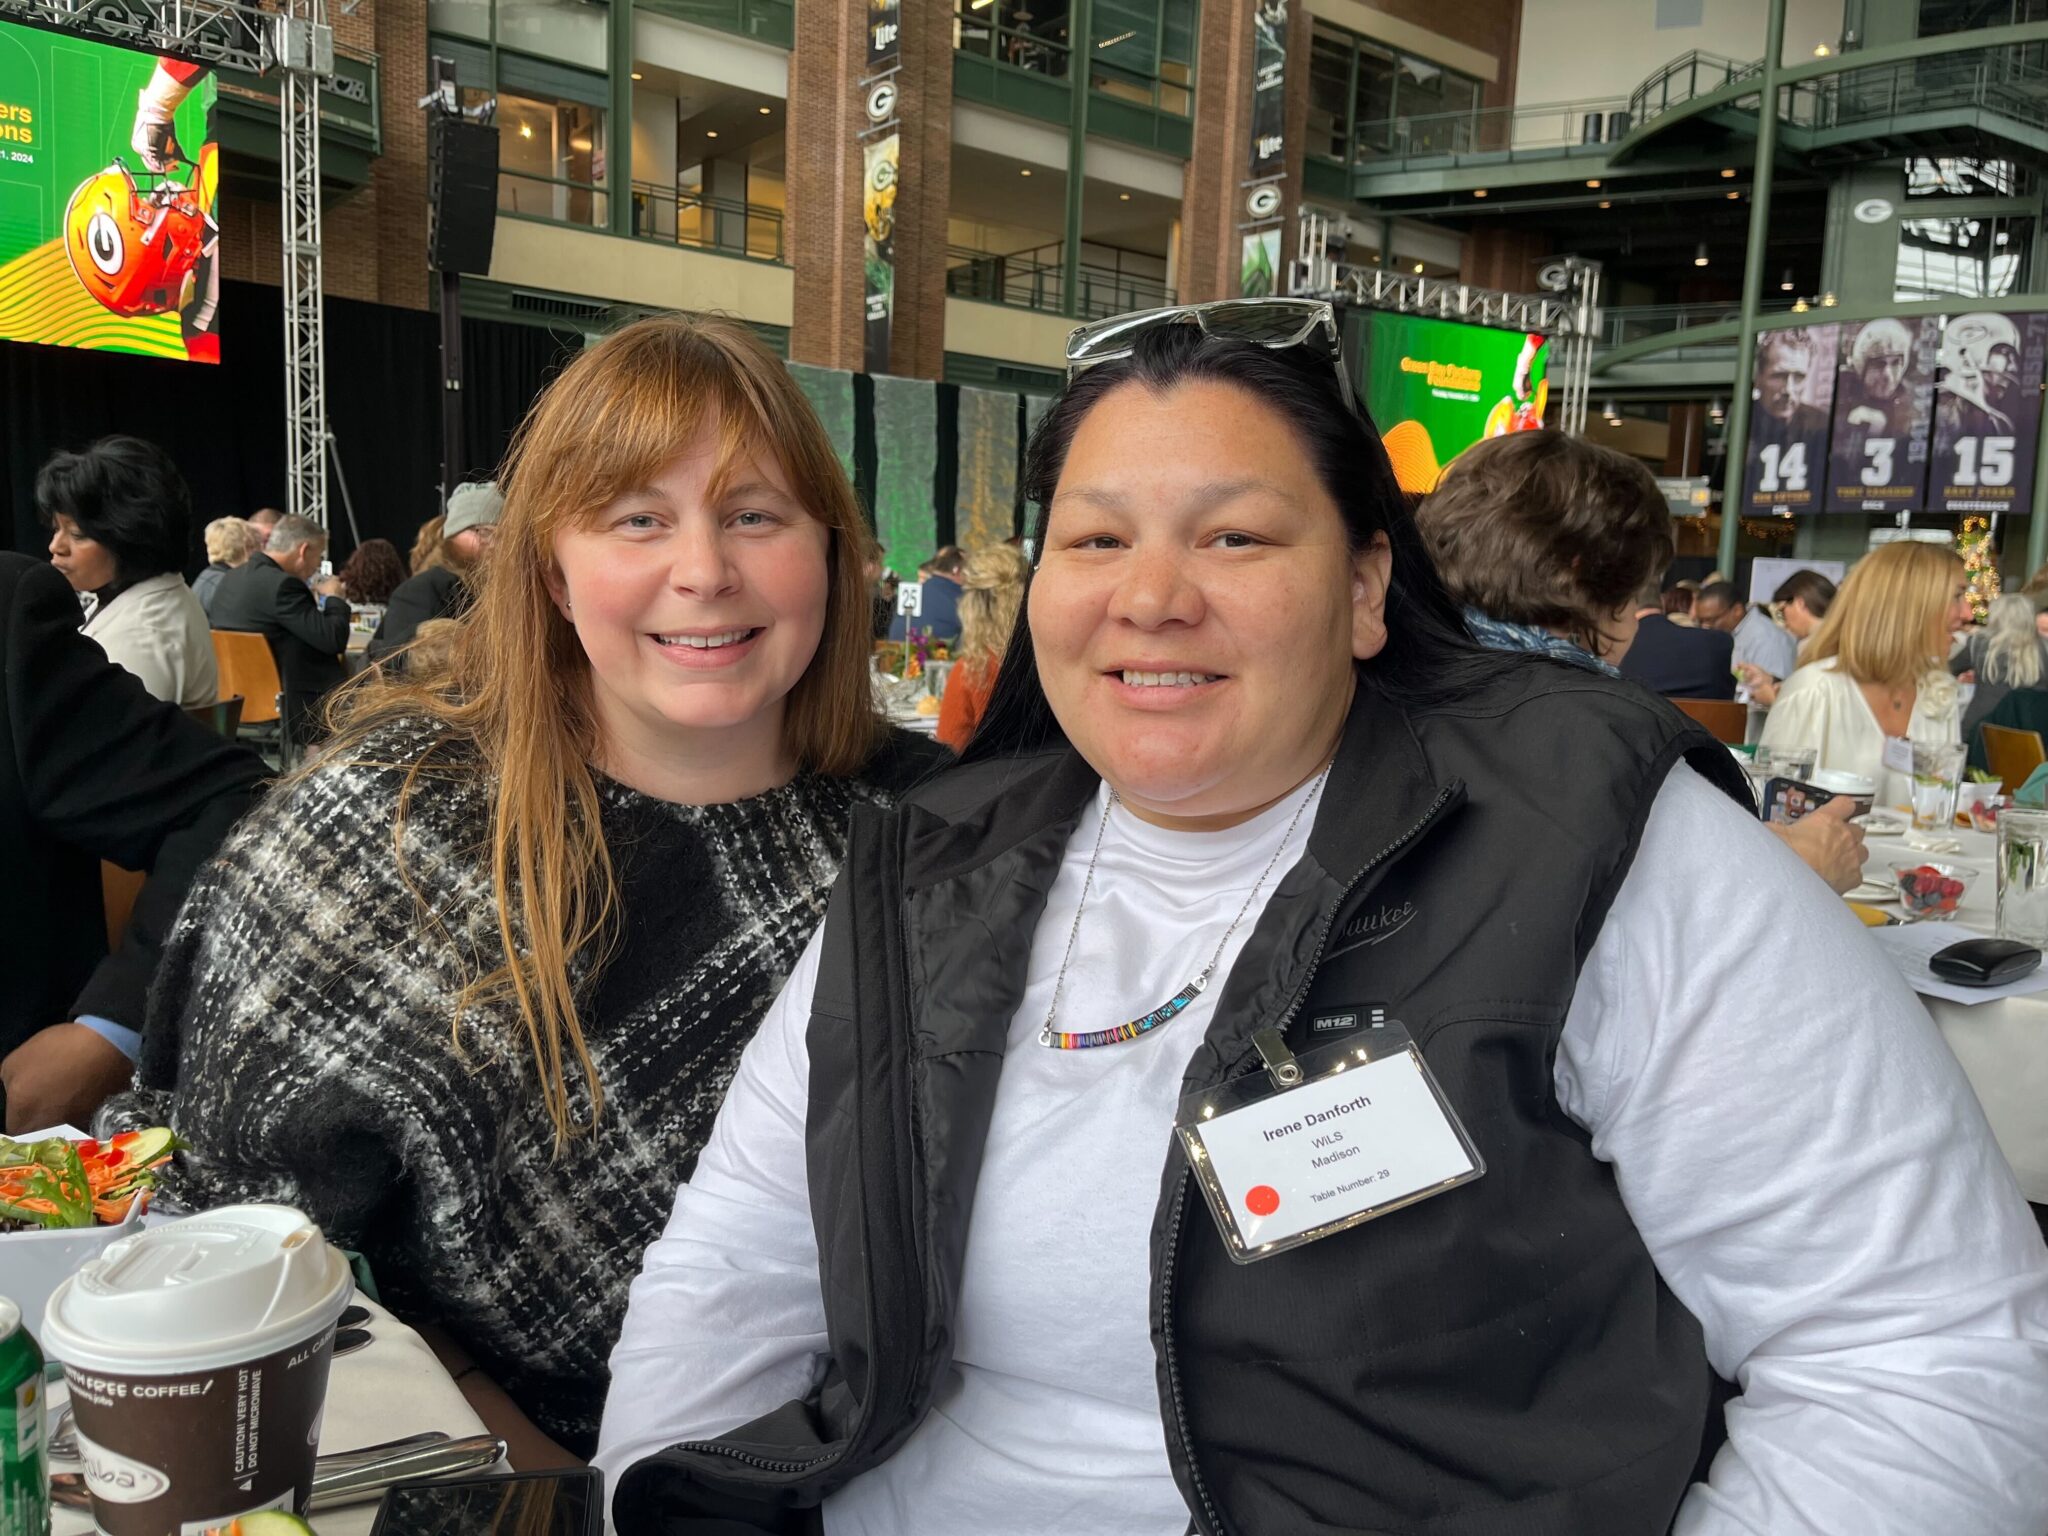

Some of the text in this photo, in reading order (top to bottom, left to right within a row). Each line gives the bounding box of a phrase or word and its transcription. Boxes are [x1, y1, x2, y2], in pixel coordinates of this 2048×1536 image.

[11, 151, 34, 164] 2024
[1759, 442, 1808, 492] 14
[1860, 438, 1896, 486] 3
[1953, 436, 2016, 486] 15
[902, 589, 917, 609] 25
[1316, 1016, 1354, 1029] M12
[1262, 1095, 1372, 1142] Irene Danforth
[1311, 1131, 1344, 1149] WiLS
[1311, 1145, 1361, 1169] Madison
[1310, 1168, 1391, 1203] Table Number: 29
[287, 1349, 310, 1369] ALL
[132, 1378, 214, 1398] COFFEE!
[235, 1368, 249, 1473] CAUTION! VERY HOT
[248, 1369, 262, 1469] DO NOT MICROWAVE
